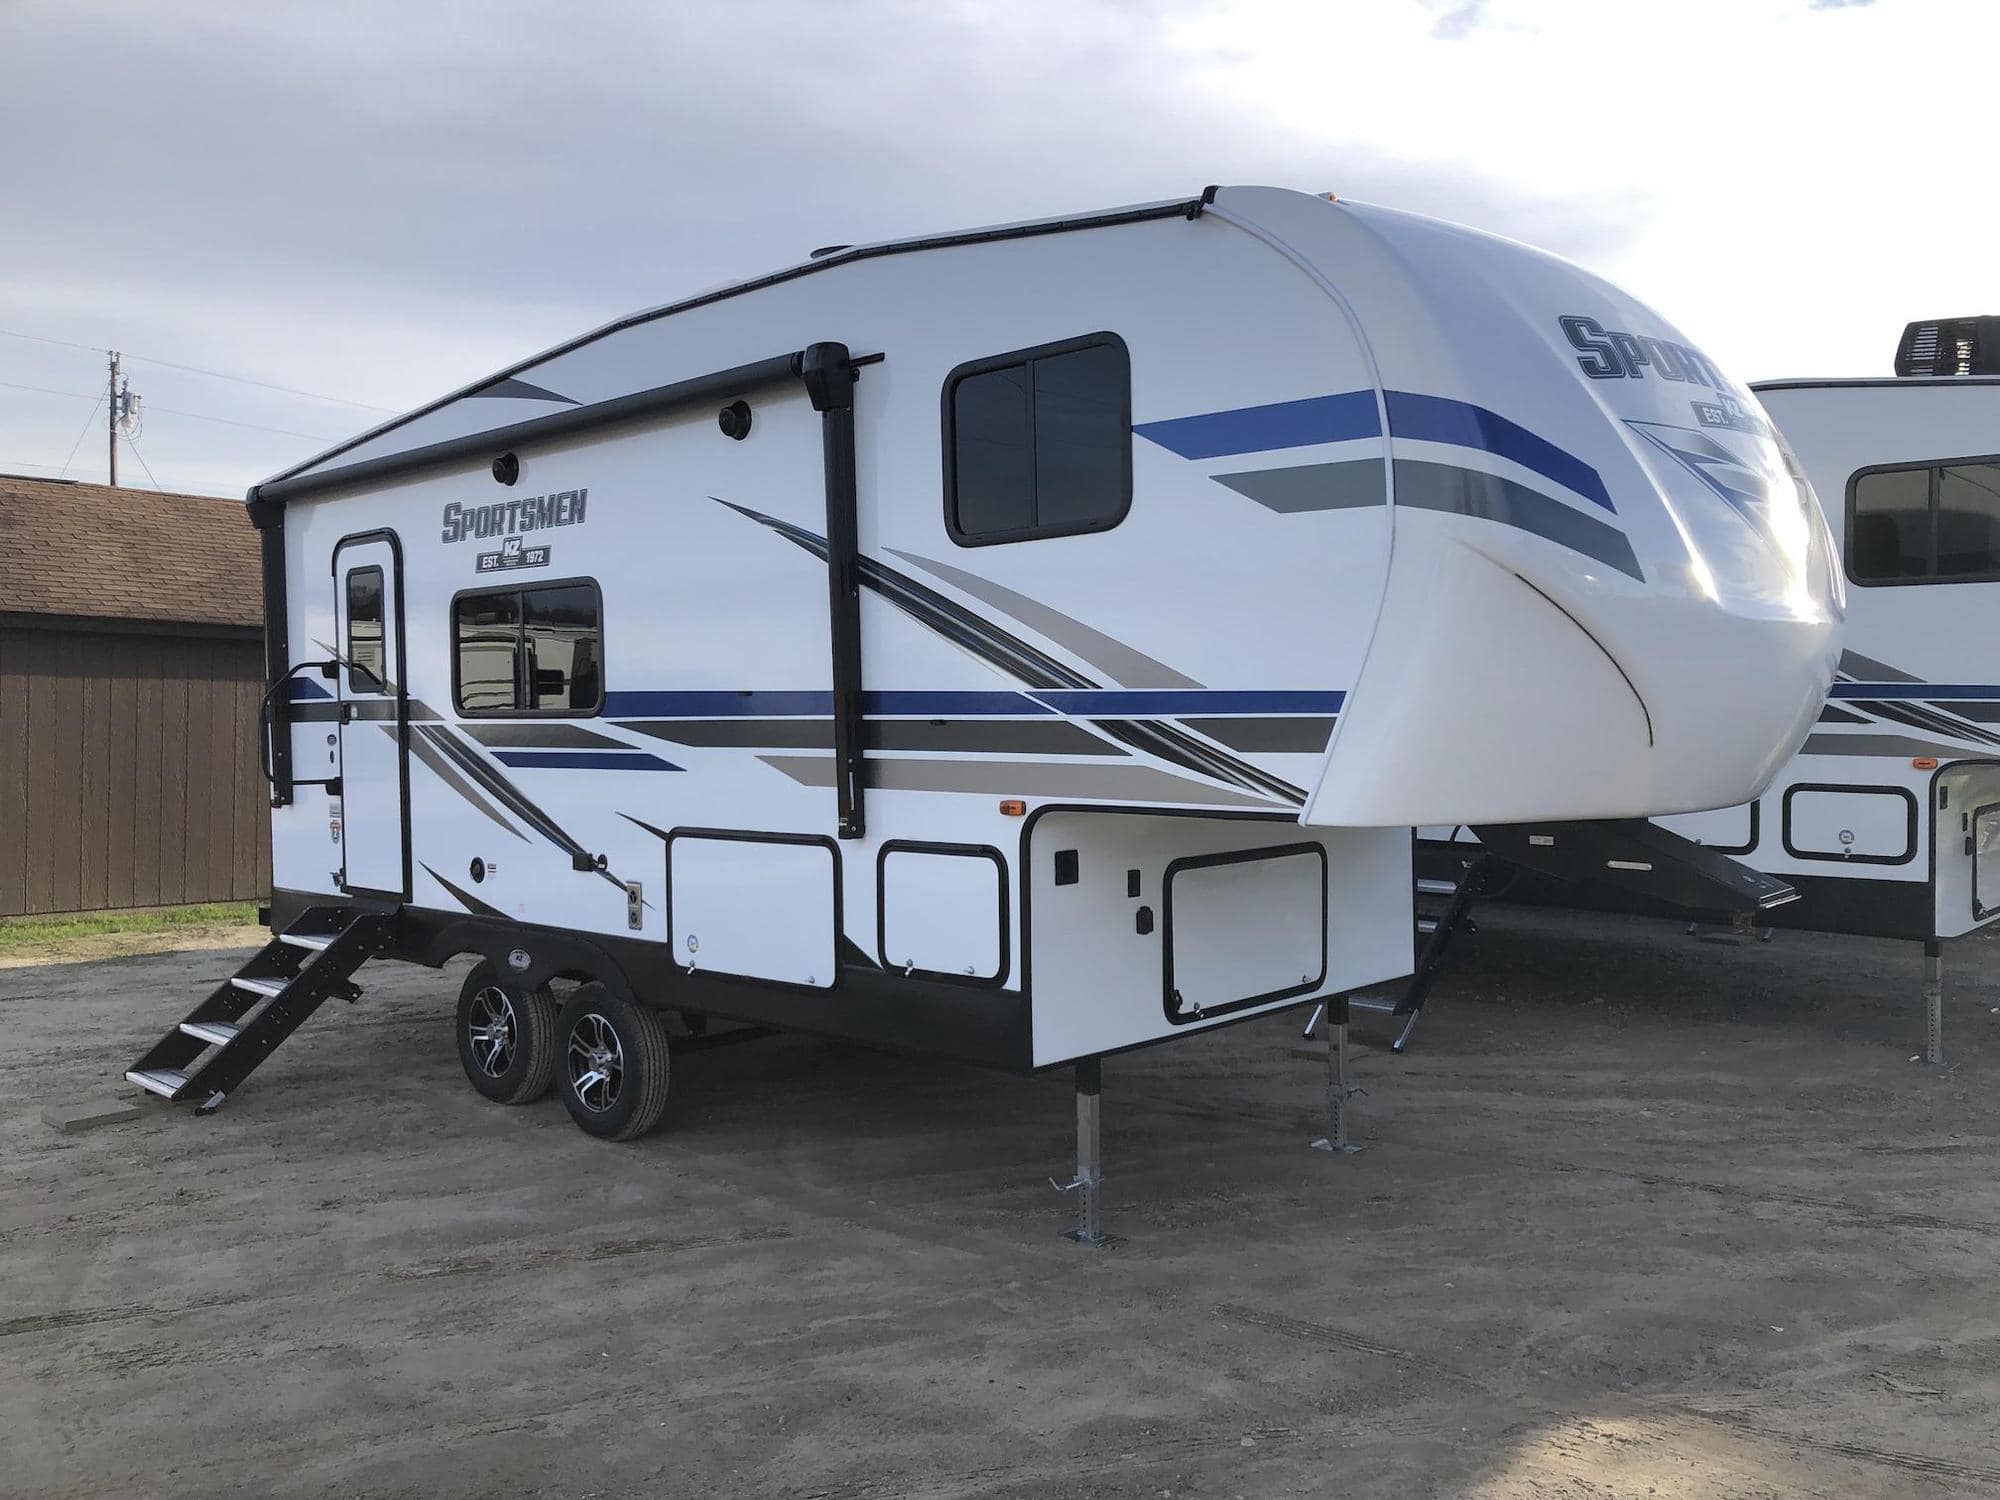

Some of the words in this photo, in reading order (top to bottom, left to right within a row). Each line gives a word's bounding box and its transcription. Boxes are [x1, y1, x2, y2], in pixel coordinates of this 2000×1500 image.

[1558, 315, 1727, 391] SPORT
[1702, 407, 1728, 424] EST.
[442, 488, 587, 543] SPORTSMEN
[504, 541, 521, 556] KZ
[482, 556, 499, 569] EST.
[526, 550, 543, 563] 1972
